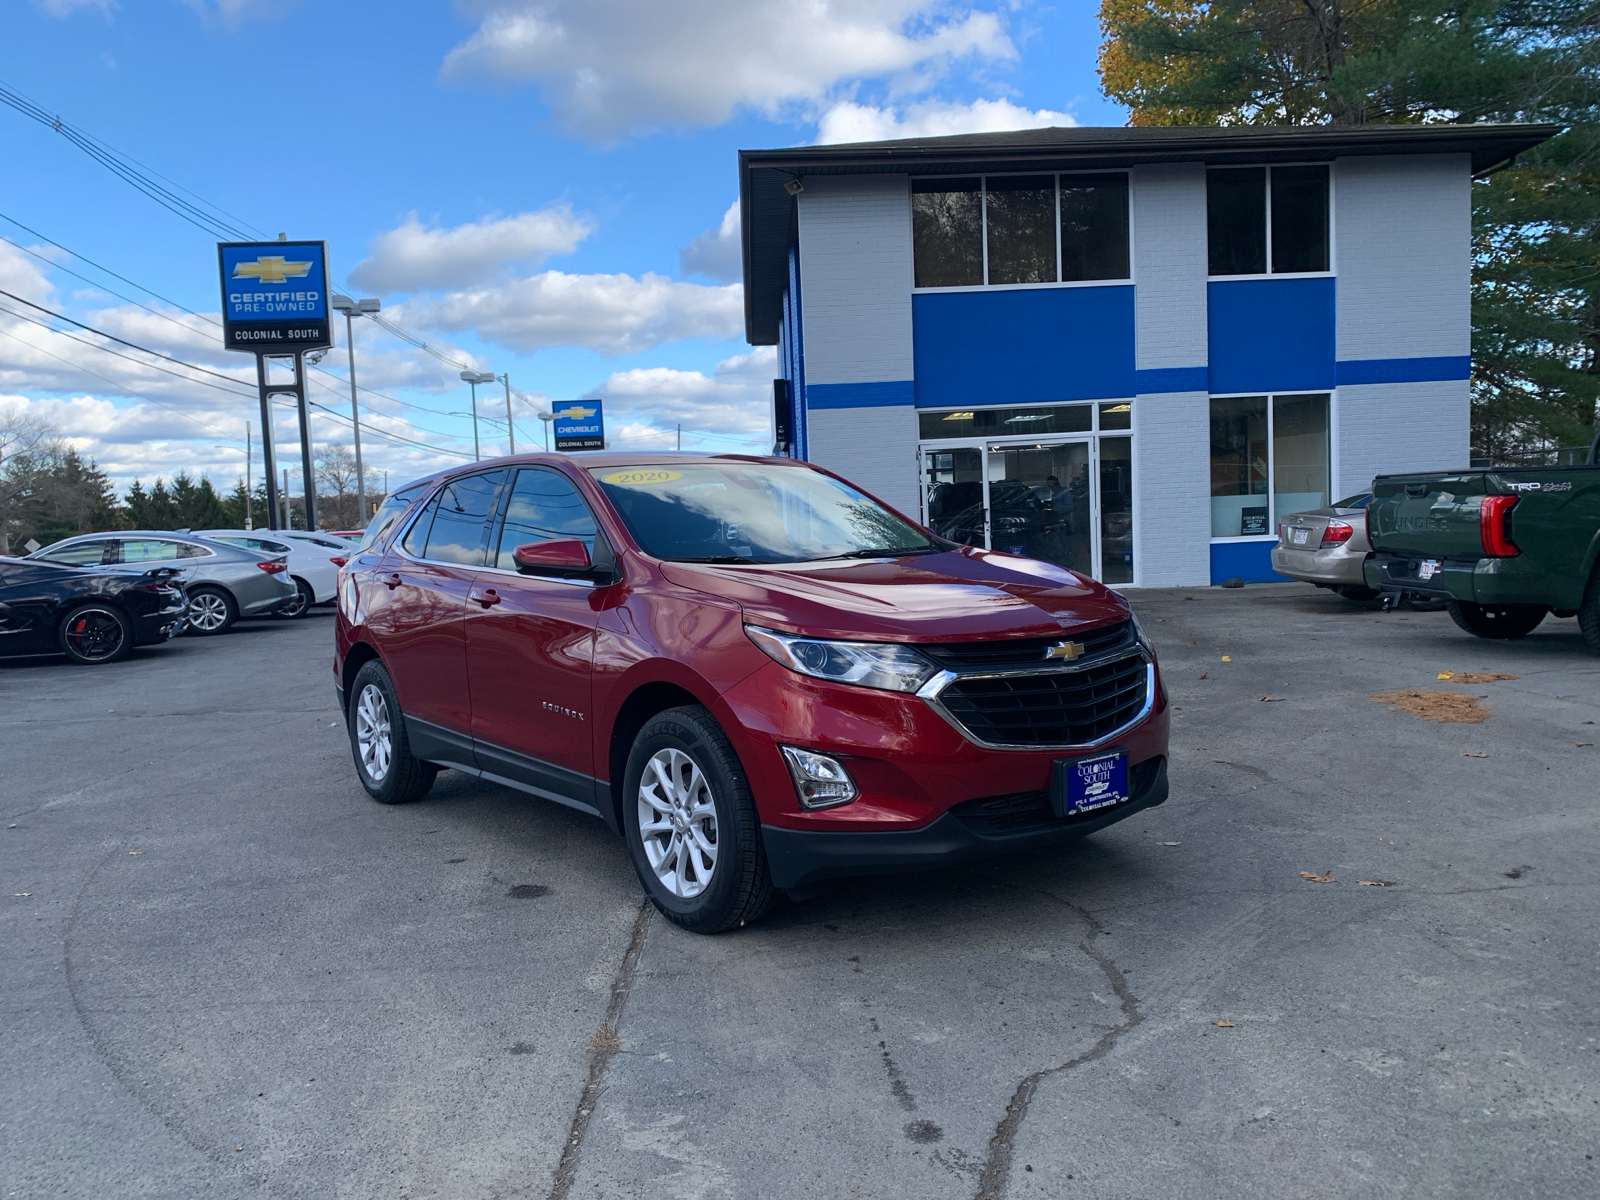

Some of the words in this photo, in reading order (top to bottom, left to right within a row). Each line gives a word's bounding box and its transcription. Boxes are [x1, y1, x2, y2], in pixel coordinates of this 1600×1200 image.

[230, 291, 319, 303] CERTIFIED
[235, 302, 315, 312] PRE-OWNED
[235, 330, 283, 340] COLONIAL
[288, 329, 319, 338] SOUTH
[558, 425, 600, 433] CHEVROLET
[618, 471, 670, 483] 2020
[1507, 482, 1541, 492] TRD
[542, 701, 584, 721] EQUINOX
[646, 722, 685, 739] KELLY
[1078, 760, 1115, 776] COLONIAL
[1084, 771, 1110, 785] SOUTH
